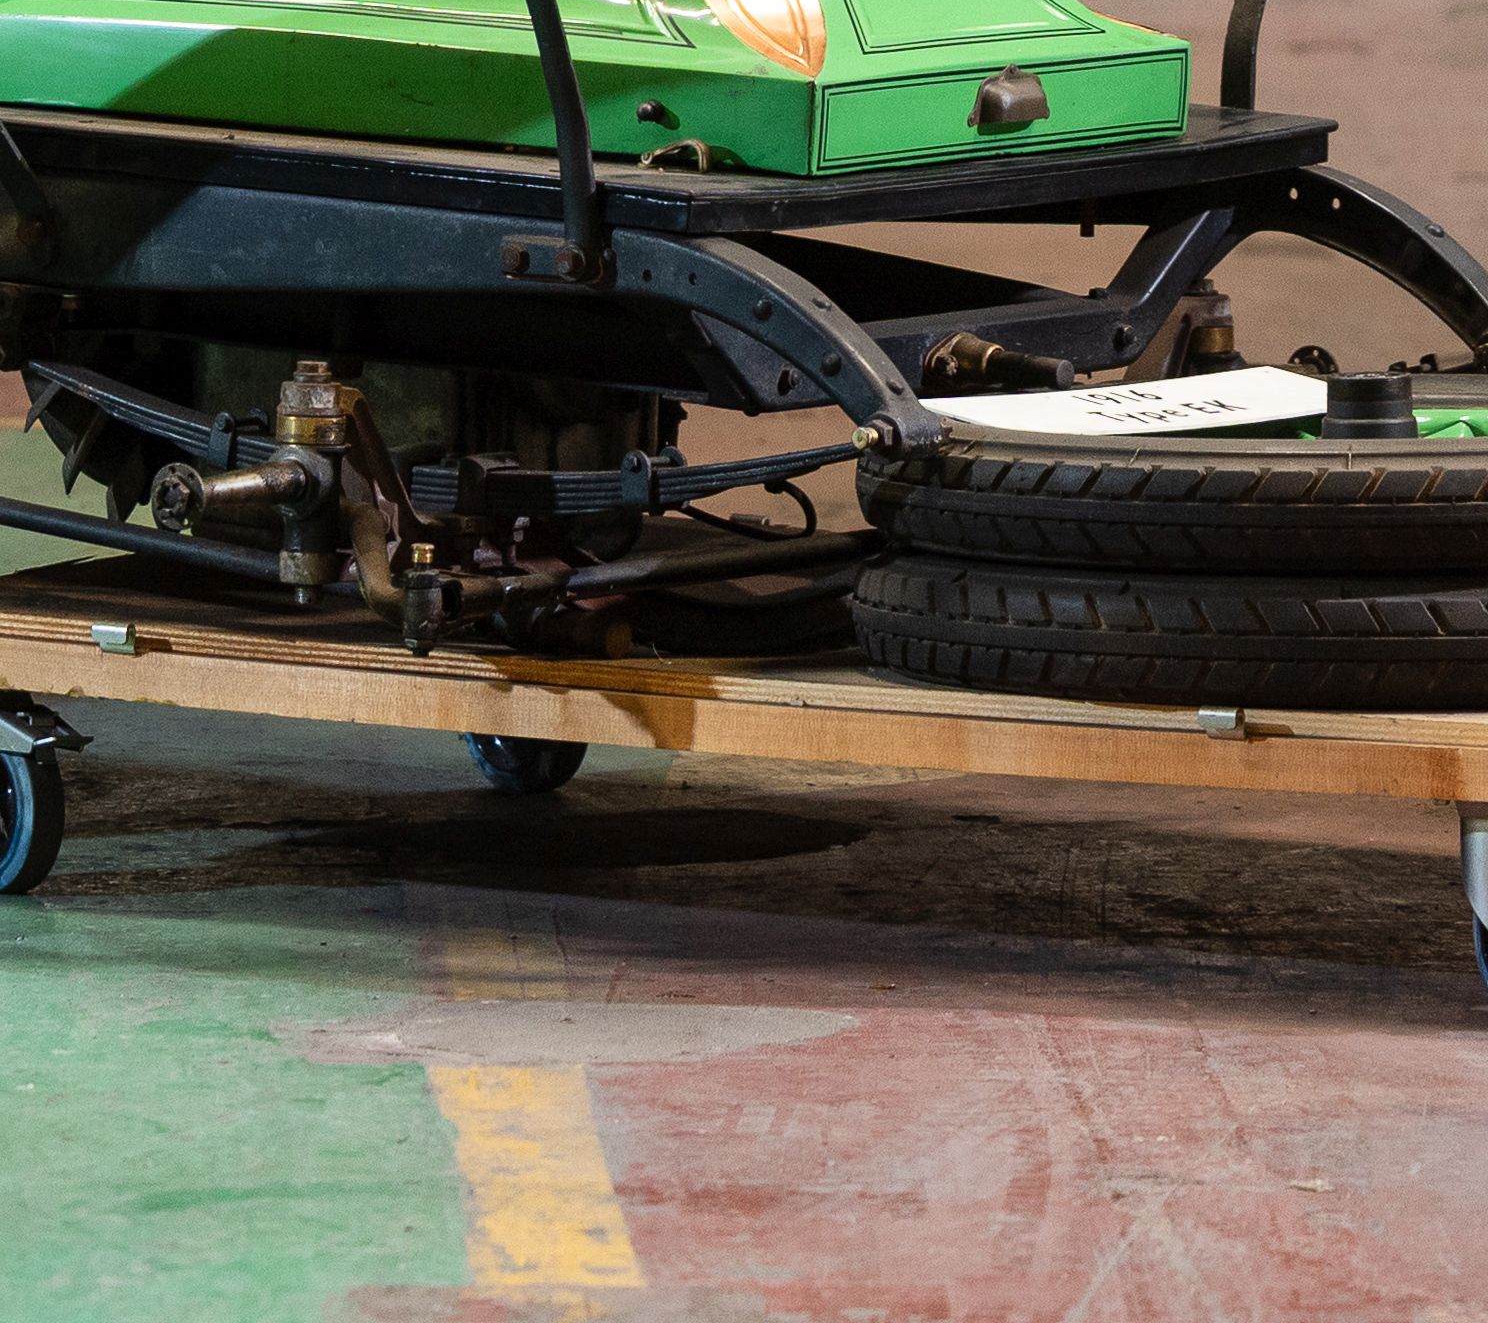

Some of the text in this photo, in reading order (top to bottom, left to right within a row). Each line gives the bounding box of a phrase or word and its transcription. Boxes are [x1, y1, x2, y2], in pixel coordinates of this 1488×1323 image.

[1071, 389, 1163, 406] 1916
[1086, 399, 1249, 424] Type EK
